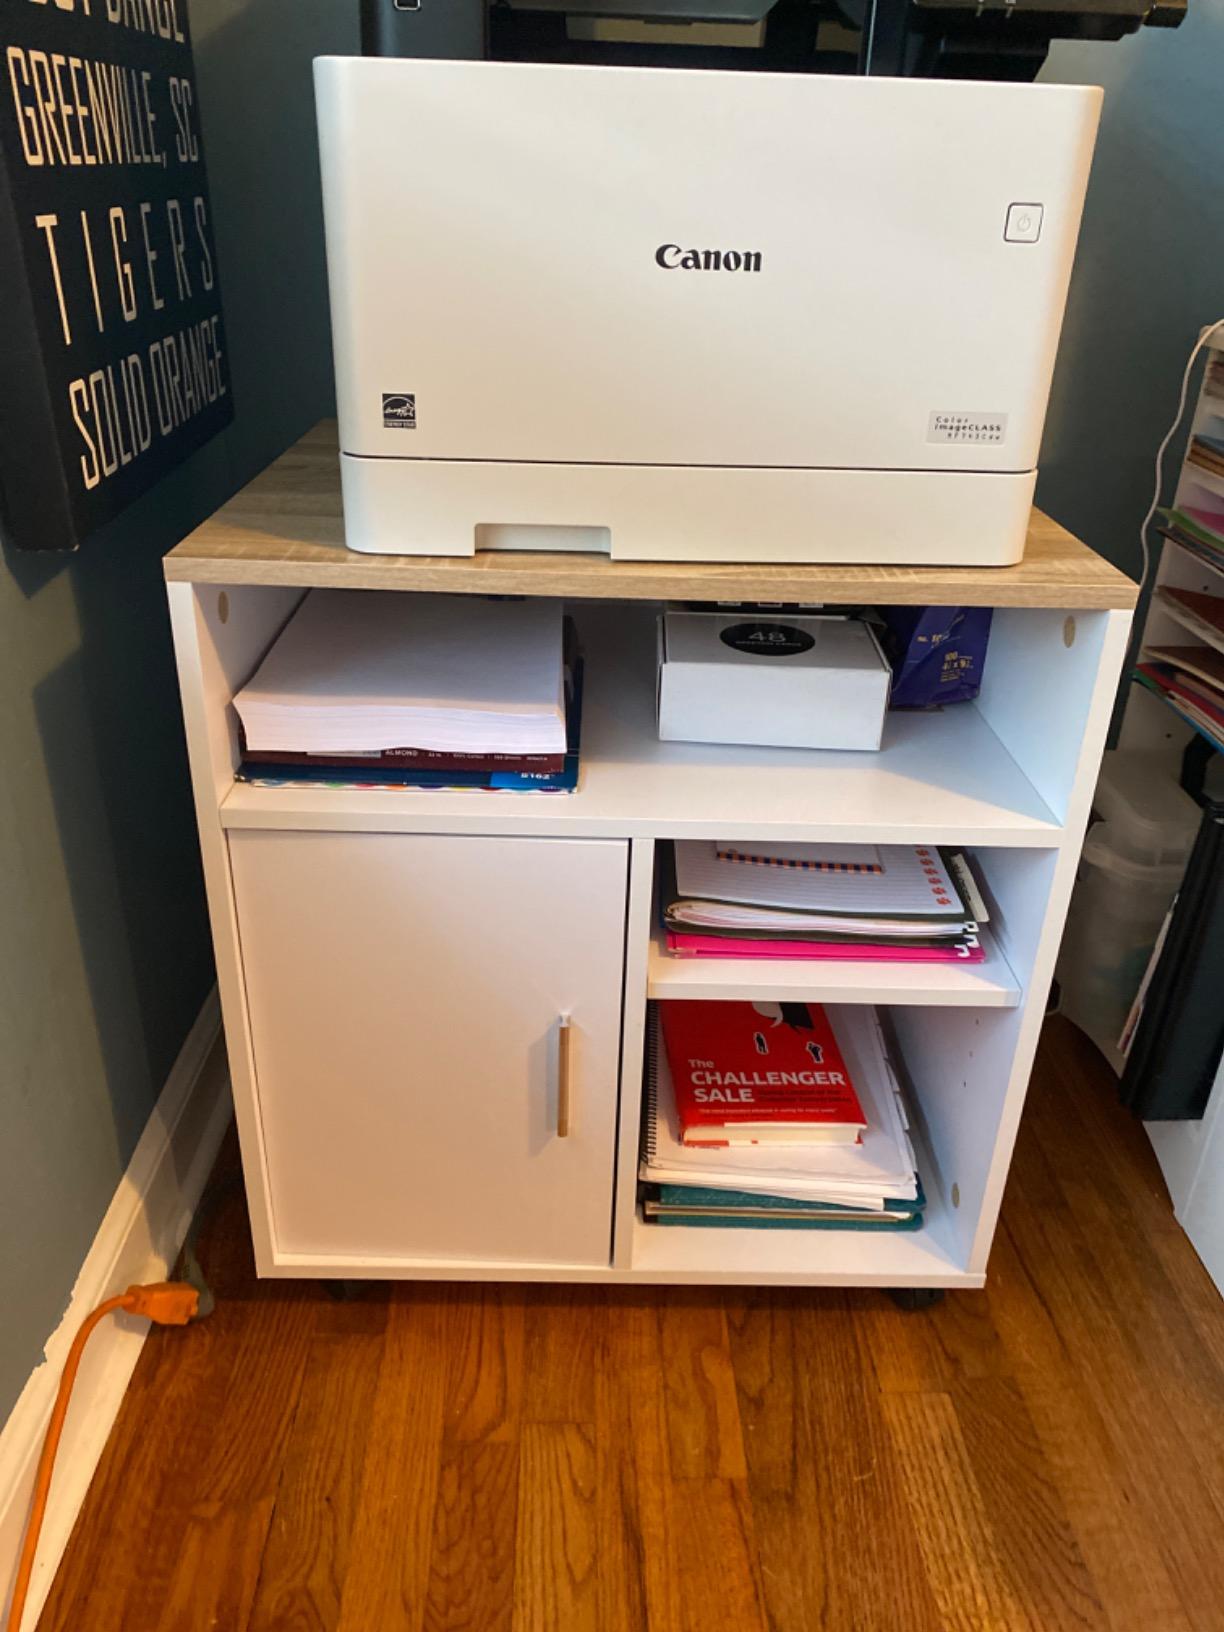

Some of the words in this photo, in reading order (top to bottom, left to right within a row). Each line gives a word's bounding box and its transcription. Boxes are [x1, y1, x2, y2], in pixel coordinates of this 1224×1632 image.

[6, 46, 167, 169] GREENVILLE,
[169, 75, 199, 163] SC
[655, 244, 763, 273] Canon
[35, 196, 214, 346] TIGERS
[67, 353, 152, 491] SOLID
[149, 315, 227, 437] ORANGE
[936, 416, 968, 424] Color
[688, 1058, 714, 1069] The
[690, 1071, 847, 1087] CHALLENGER
[694, 1087, 755, 1104] SALE
